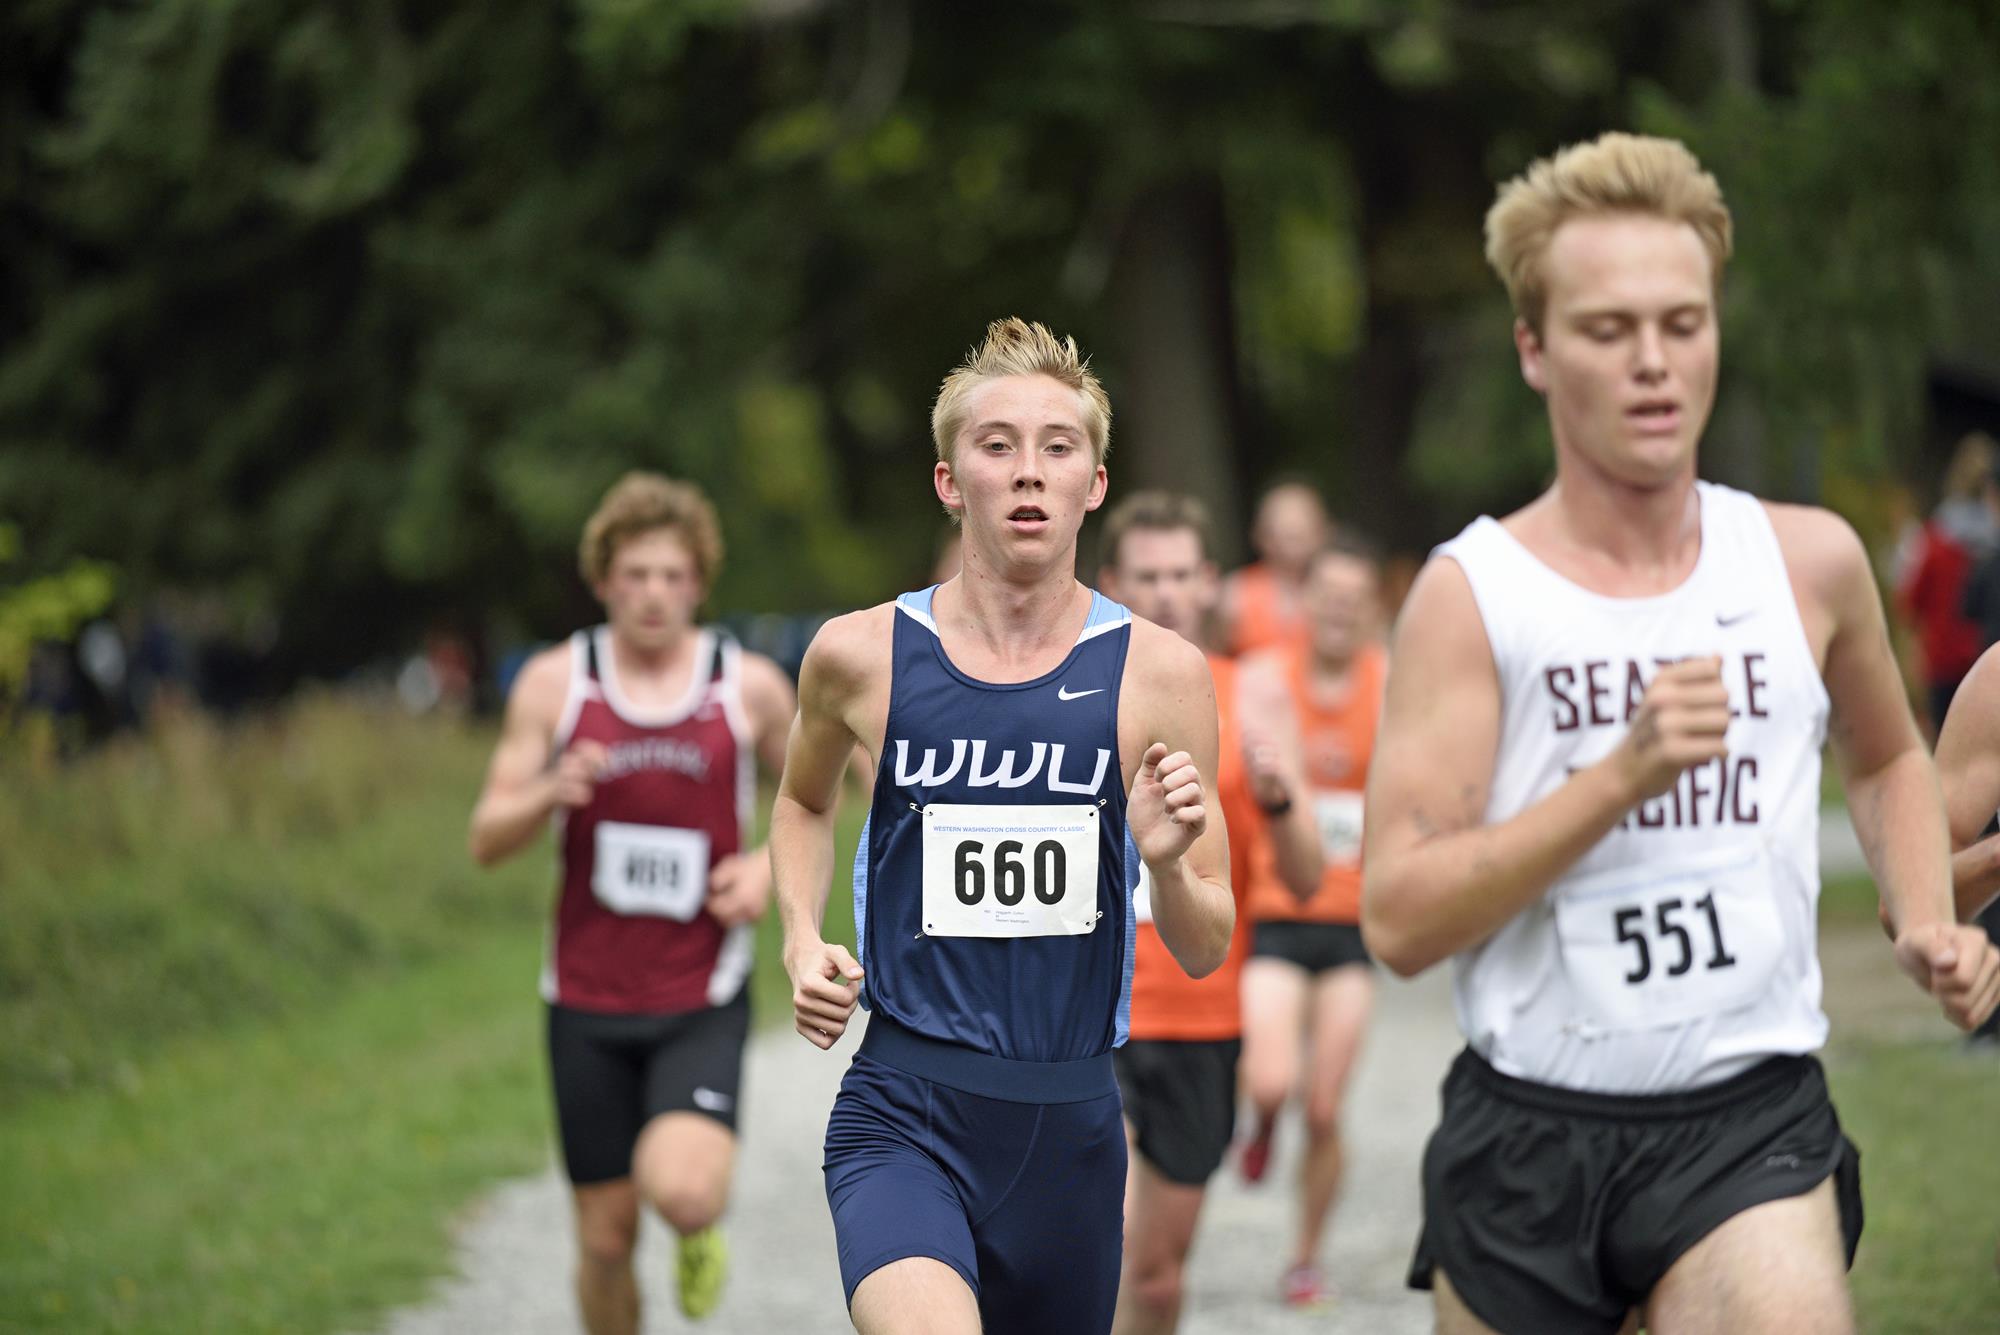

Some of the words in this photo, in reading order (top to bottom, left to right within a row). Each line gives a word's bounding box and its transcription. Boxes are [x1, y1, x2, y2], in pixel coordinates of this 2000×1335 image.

[1545, 654, 1768, 732] SEAE
[894, 739, 1111, 796] WWU
[954, 839, 1066, 906] 660
[1613, 888, 1736, 984] 551
